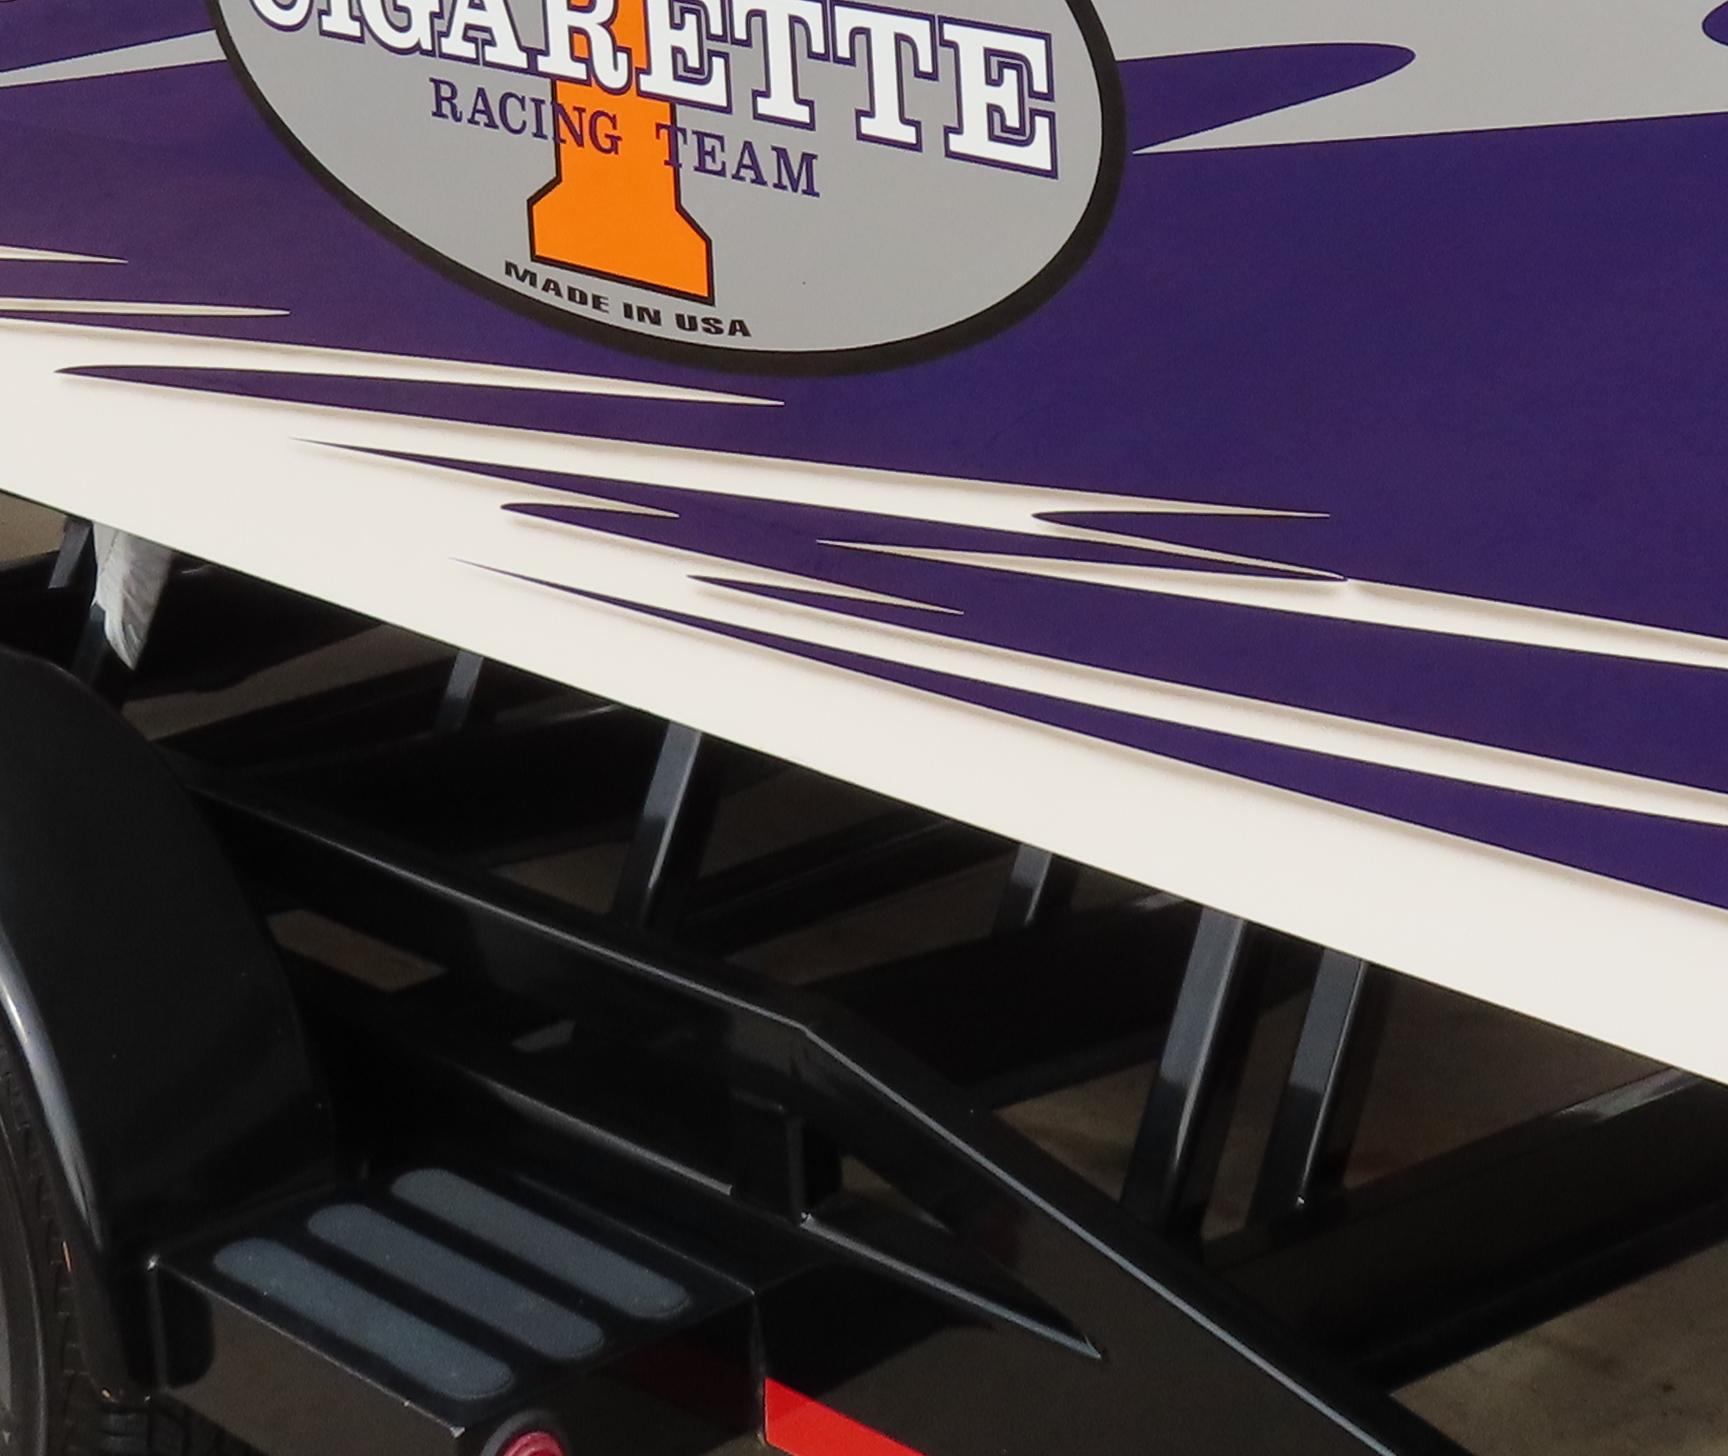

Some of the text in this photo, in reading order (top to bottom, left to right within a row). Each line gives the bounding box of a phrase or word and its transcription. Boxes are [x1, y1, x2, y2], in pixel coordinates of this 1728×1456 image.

[429, 77, 821, 199] RACING TEAM
[504, 260, 753, 338] MADE IN USA
